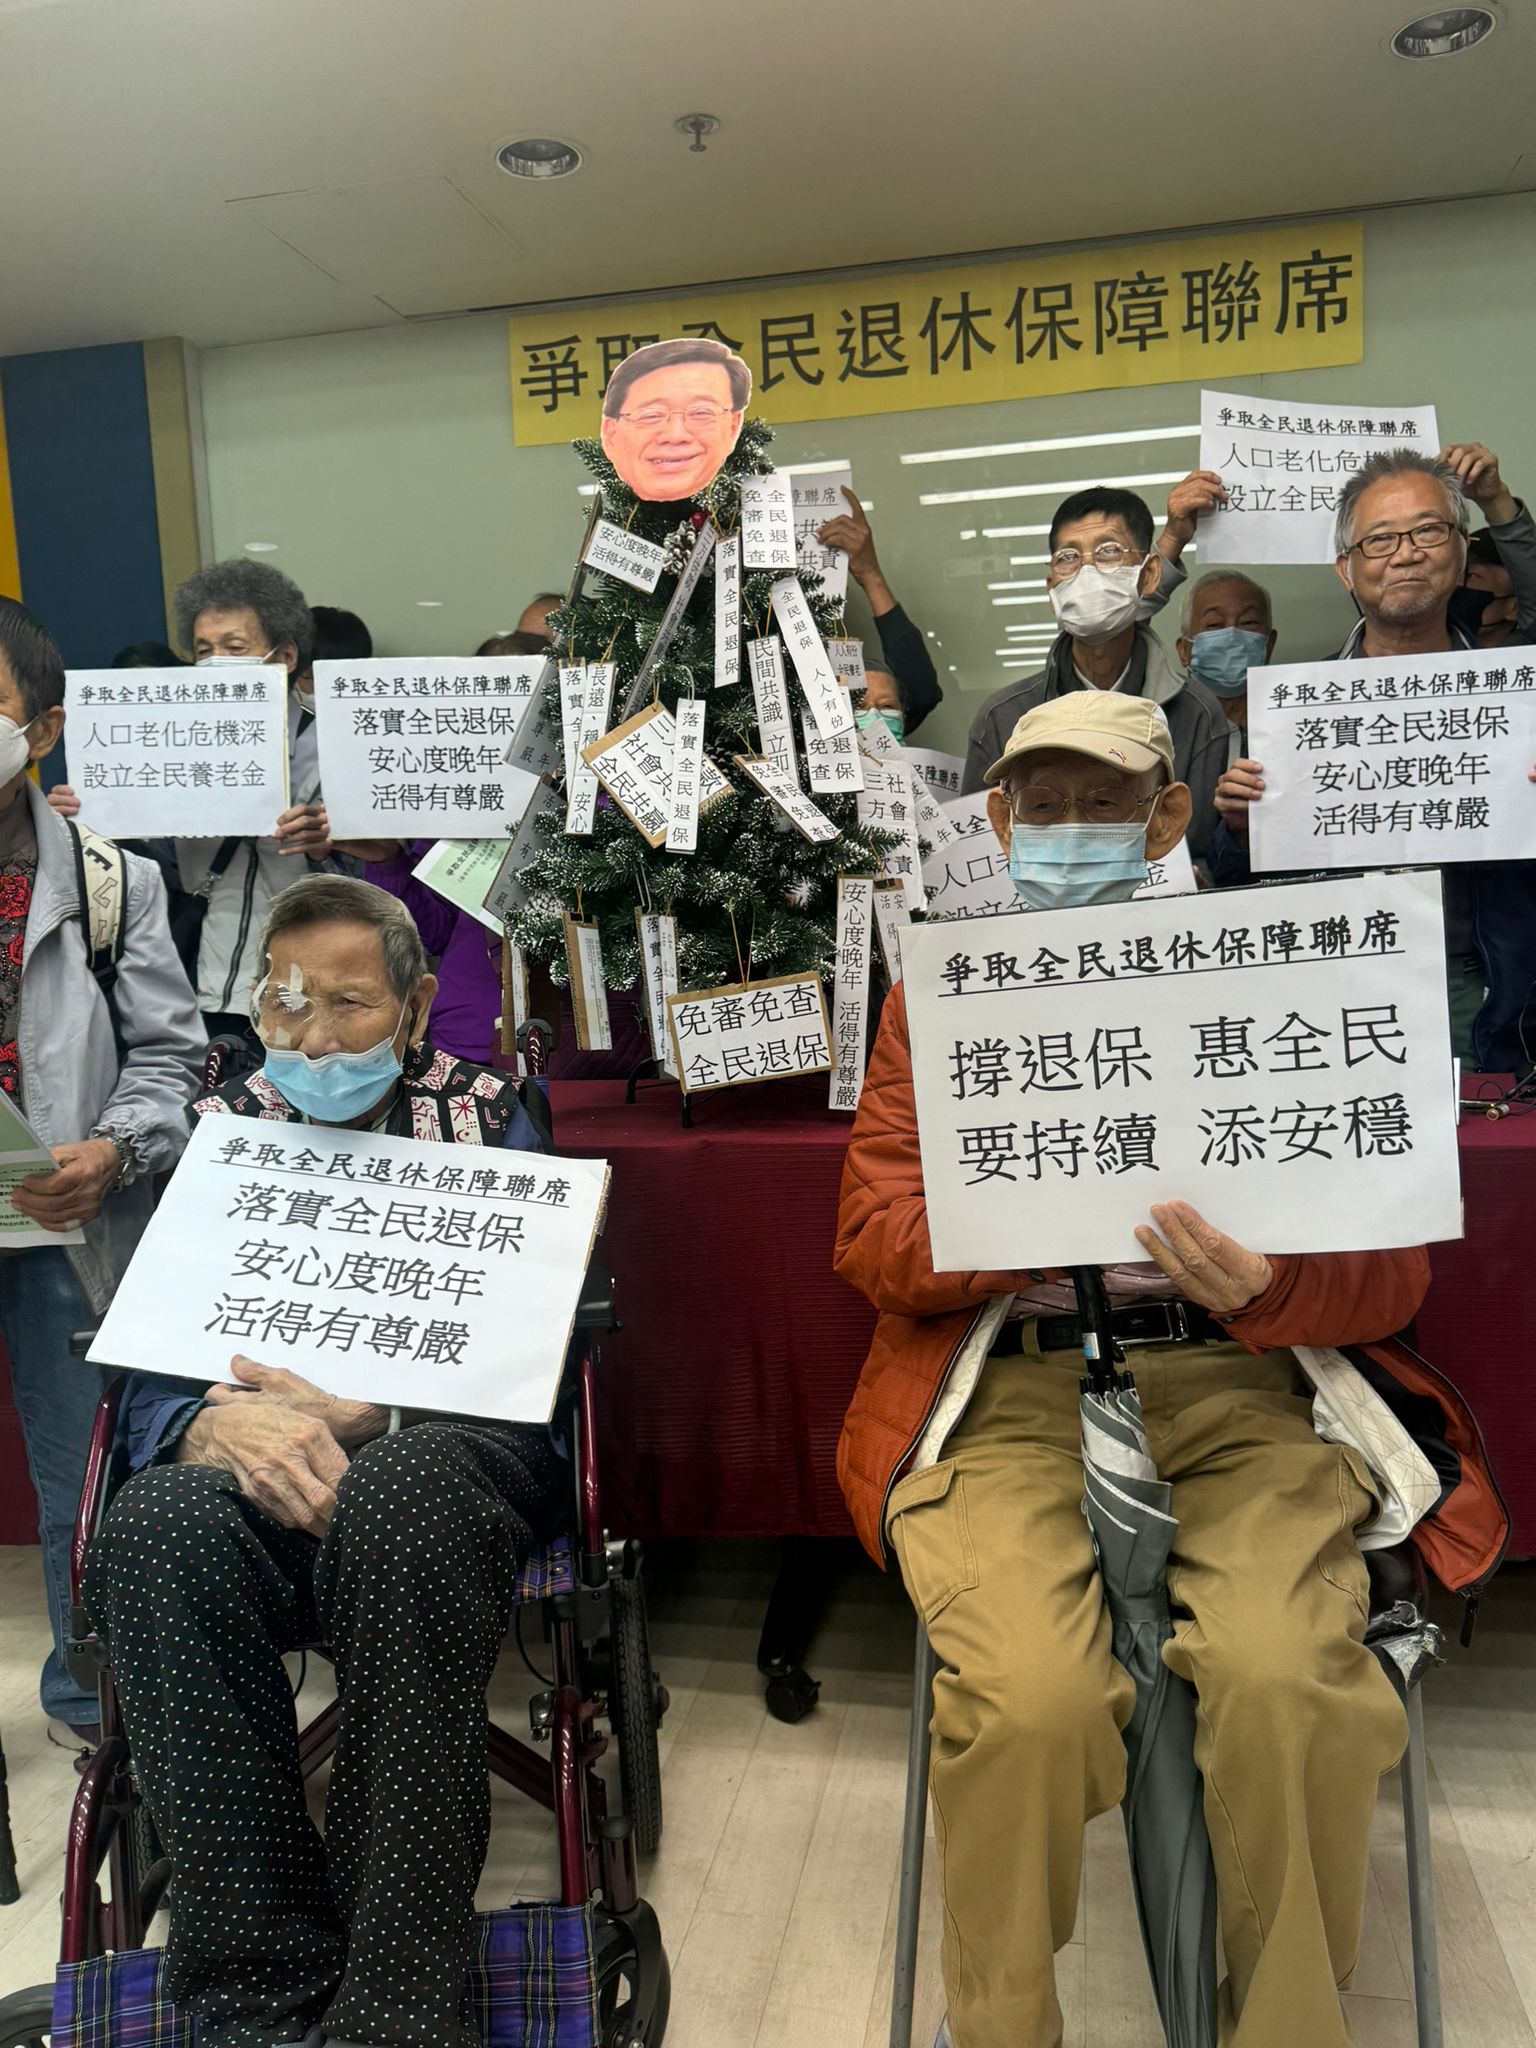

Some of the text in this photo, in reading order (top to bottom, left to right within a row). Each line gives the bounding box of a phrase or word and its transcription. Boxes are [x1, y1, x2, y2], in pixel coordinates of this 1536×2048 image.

[1218, 407, 1417, 437] 爭取全民退休保障聯席
[601, 526, 663, 562] 安心度晚年
[744, 489, 766, 564] 免審免查
[767, 489, 790, 564] 全民退保
[591, 545, 656, 584] 活得有尊嚴
[721, 541, 740, 675] 落實全民退保
[79, 680, 269, 704] 爭取全民退休保障聯席
[331, 674, 533, 698] 爭取全民退休保障聯席
[754, 639, 784, 724] 民間共識
[781, 591, 843, 728] 全民退保 人人有份
[1270, 665, 1536, 708] 爭取全民退休保障聯席
[83, 720, 266, 749] 人口老化危機深
[352, 707, 515, 736] 落實全民退保
[565, 670, 584, 752] 落實全
[1295, 705, 1510, 751] 落實全民退保
[83, 760, 266, 789] 設立全民養老金
[368, 746, 503, 774] 安心度晚年
[571, 667, 607, 833] 長遠、穩、安心
[621, 732, 673, 803] 社會共
[649, 714, 722, 795] 三款
[672, 712, 701, 844] 落實全民退保
[1312, 752, 1490, 794] 安心度晚年
[371, 783, 506, 812] 活得有尊嚴
[876, 735, 951, 844] 安度晚年
[1313, 796, 1490, 836] 活得有尊嚴
[938, 909, 1402, 995] 爭取全民退休保障聯席
[675, 984, 820, 1040] 免審免查
[835, 882, 867, 1107] 安心度晚年 活得有尊嚴
[686, 1033, 830, 1088] 全民退保
[948, 1004, 1408, 1101] 撐退保 惠全民
[217, 1137, 572, 1206] 爭取全民退休保障聯席
[956, 1092, 1414, 1186] 要持續 添安穩
[226, 1182, 526, 1255] 落實全民退保
[231, 1239, 486, 1306] 安心度晚年
[204, 1292, 470, 1366] 活得有尊嚴
